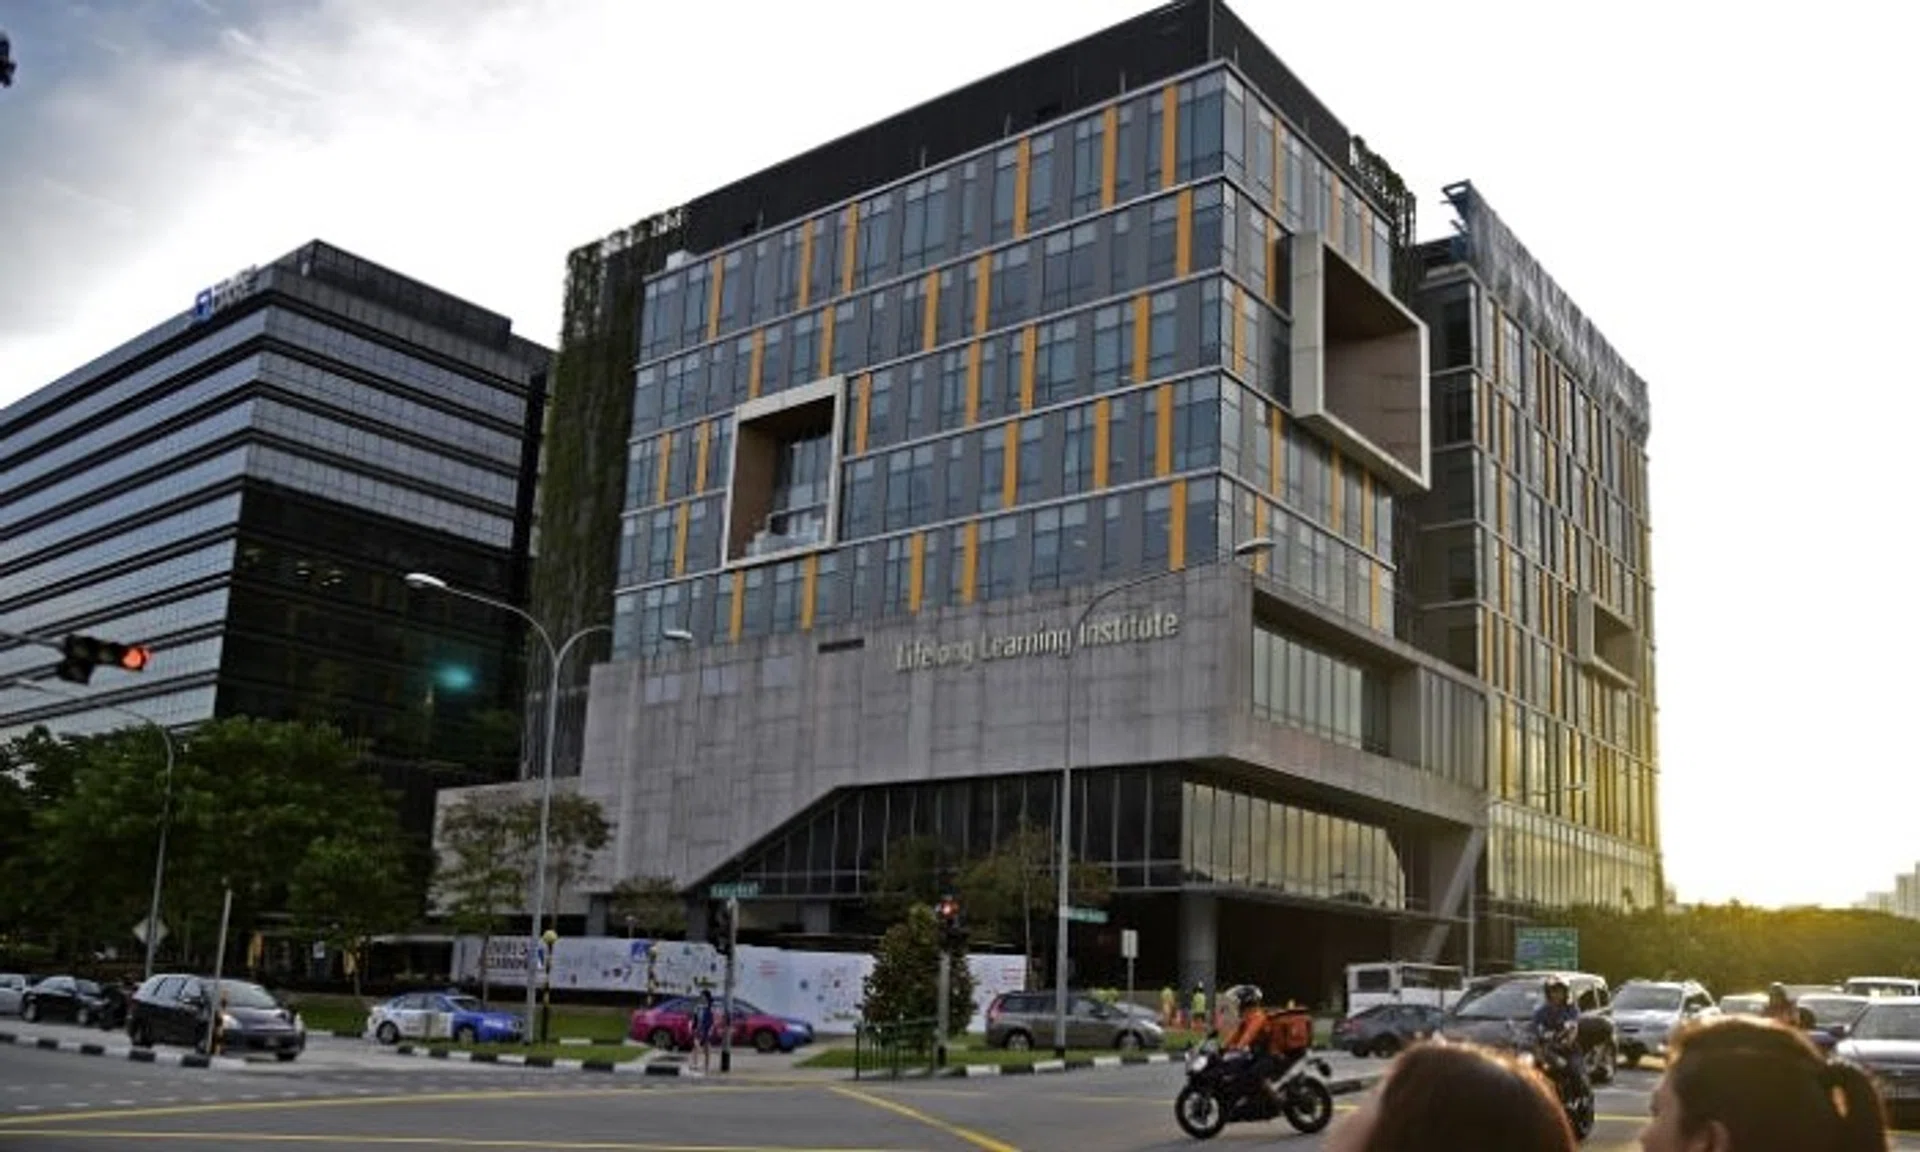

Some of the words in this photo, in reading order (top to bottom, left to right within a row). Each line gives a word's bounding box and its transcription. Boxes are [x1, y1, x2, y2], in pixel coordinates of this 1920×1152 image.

[896, 636, 974, 671] Lifelong
[980, 622, 1072, 659] Learning
[1079, 611, 1179, 647] Institute
